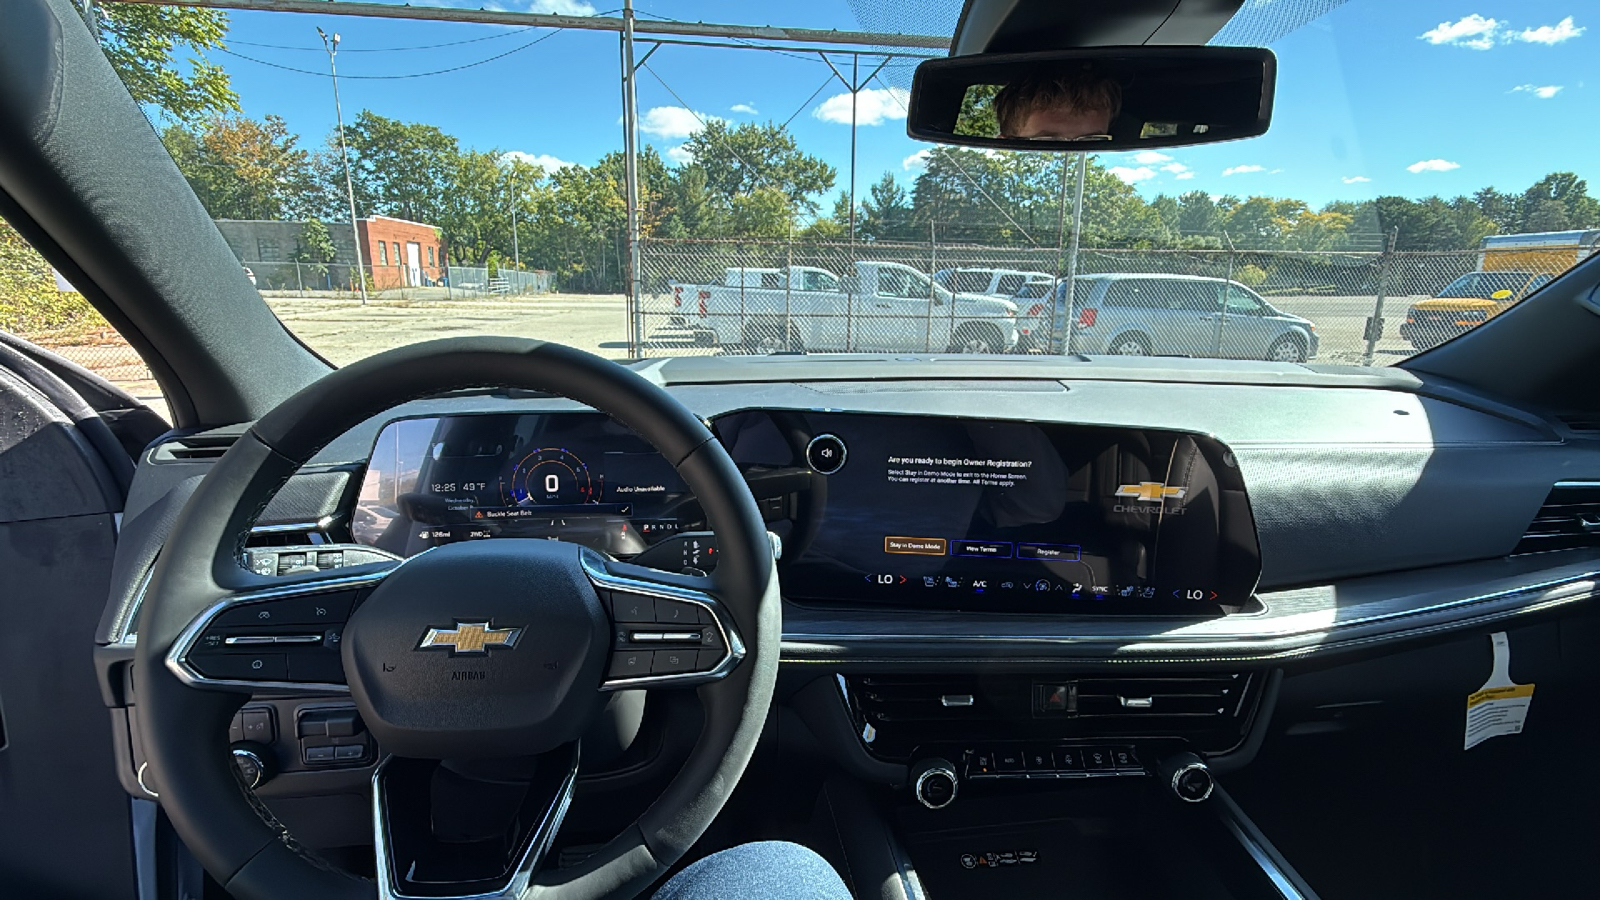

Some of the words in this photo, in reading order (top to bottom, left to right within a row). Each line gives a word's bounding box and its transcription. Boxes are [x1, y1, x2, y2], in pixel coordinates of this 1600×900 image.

[901, 457, 914, 465] you
[915, 457, 934, 466] ready
[943, 458, 962, 467] begin
[963, 458, 986, 466] Owner
[987, 459, 1032, 468] Registration?
[431, 482, 456, 493] 12:25
[462, 482, 476, 491] 49
[545, 474, 559, 493] 0
[486, 510, 506, 518] Buckle
[1112, 504, 1188, 516] CHEVROLET
[889, 541, 902, 549] Stay
[1037, 548, 1061, 556] Register
[877, 574, 894, 585] LO
[972, 580, 988, 588] A/C
[1186, 589, 1204, 600] LO
